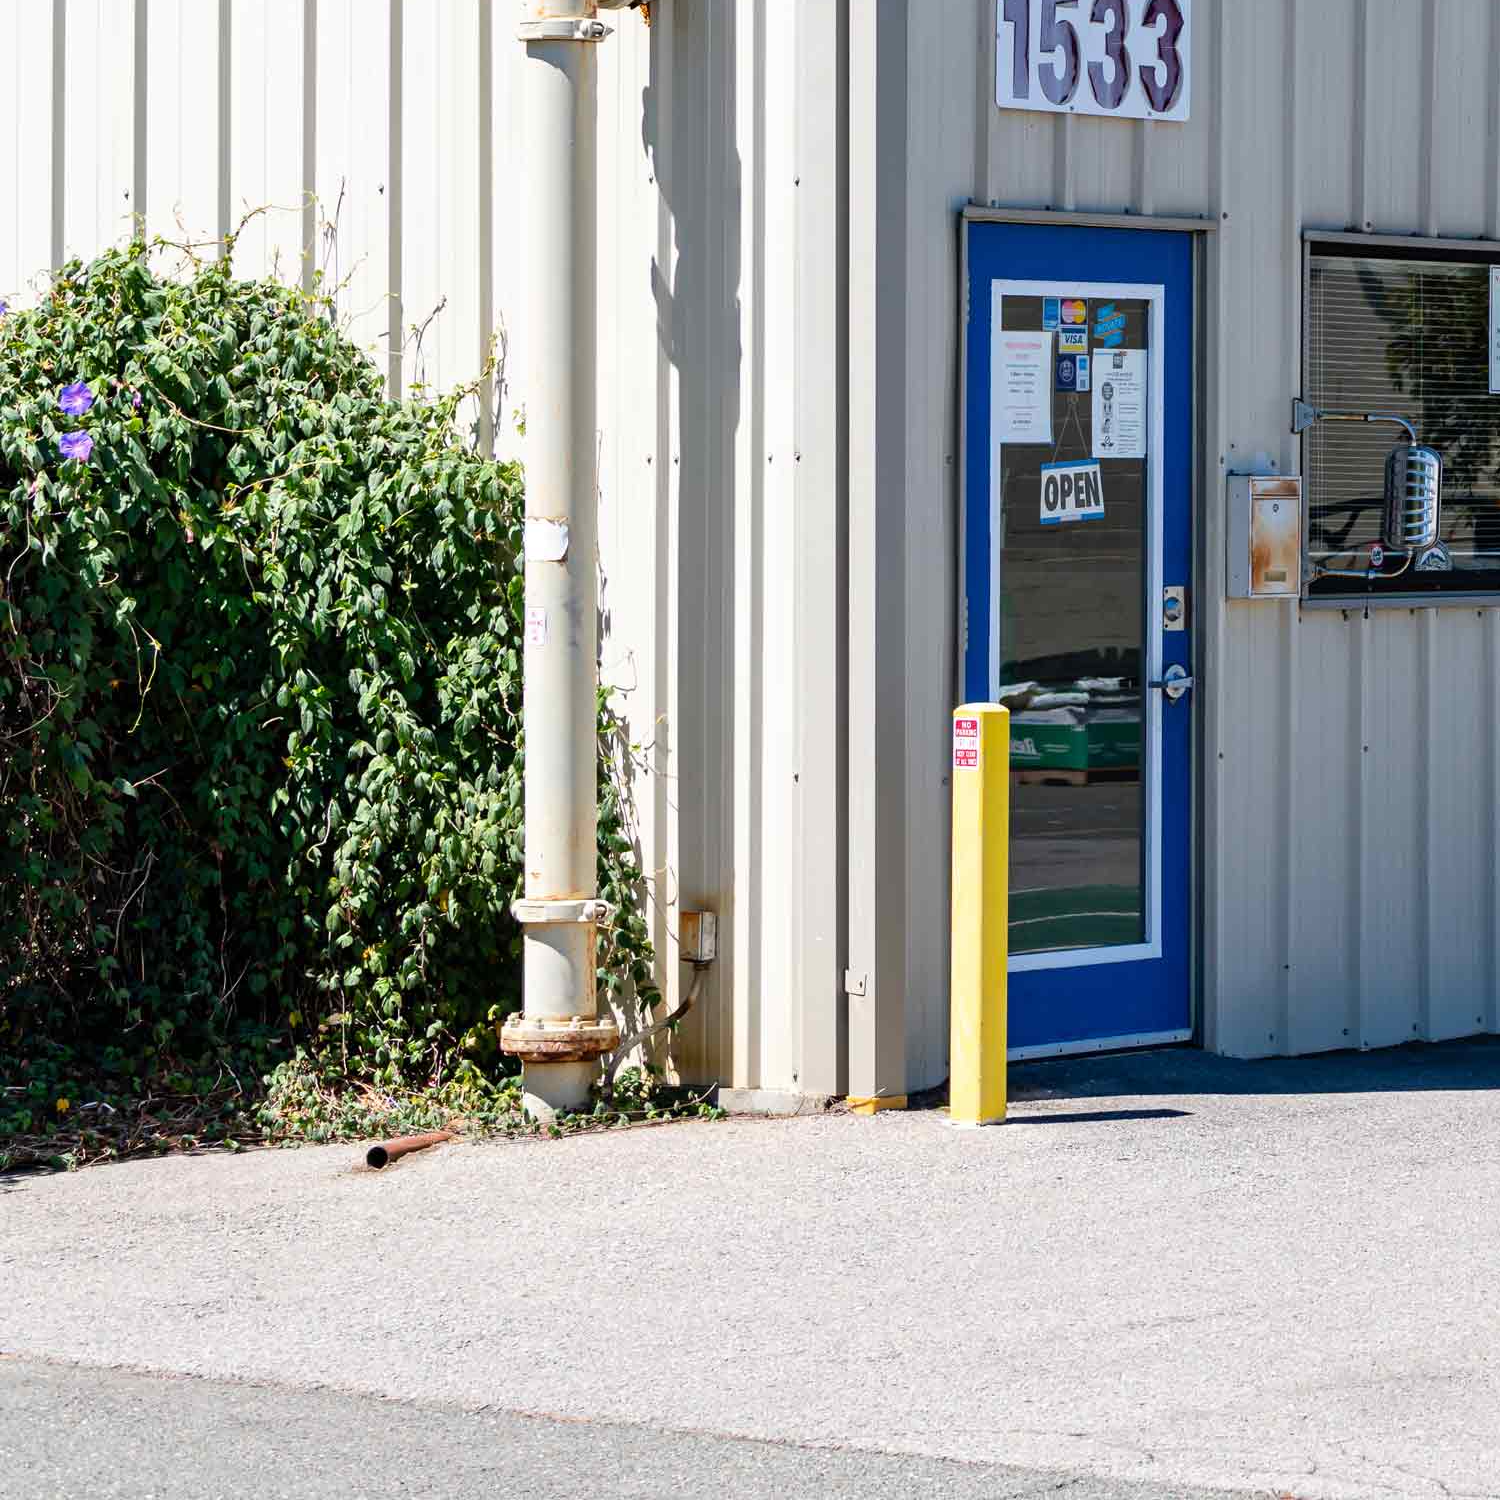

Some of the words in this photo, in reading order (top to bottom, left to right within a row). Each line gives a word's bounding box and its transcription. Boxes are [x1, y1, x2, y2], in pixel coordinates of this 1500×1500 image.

[1064, 332, 1084, 344] VISA
[1044, 470, 1101, 512] OPEN
[961, 721, 972, 729] NO
